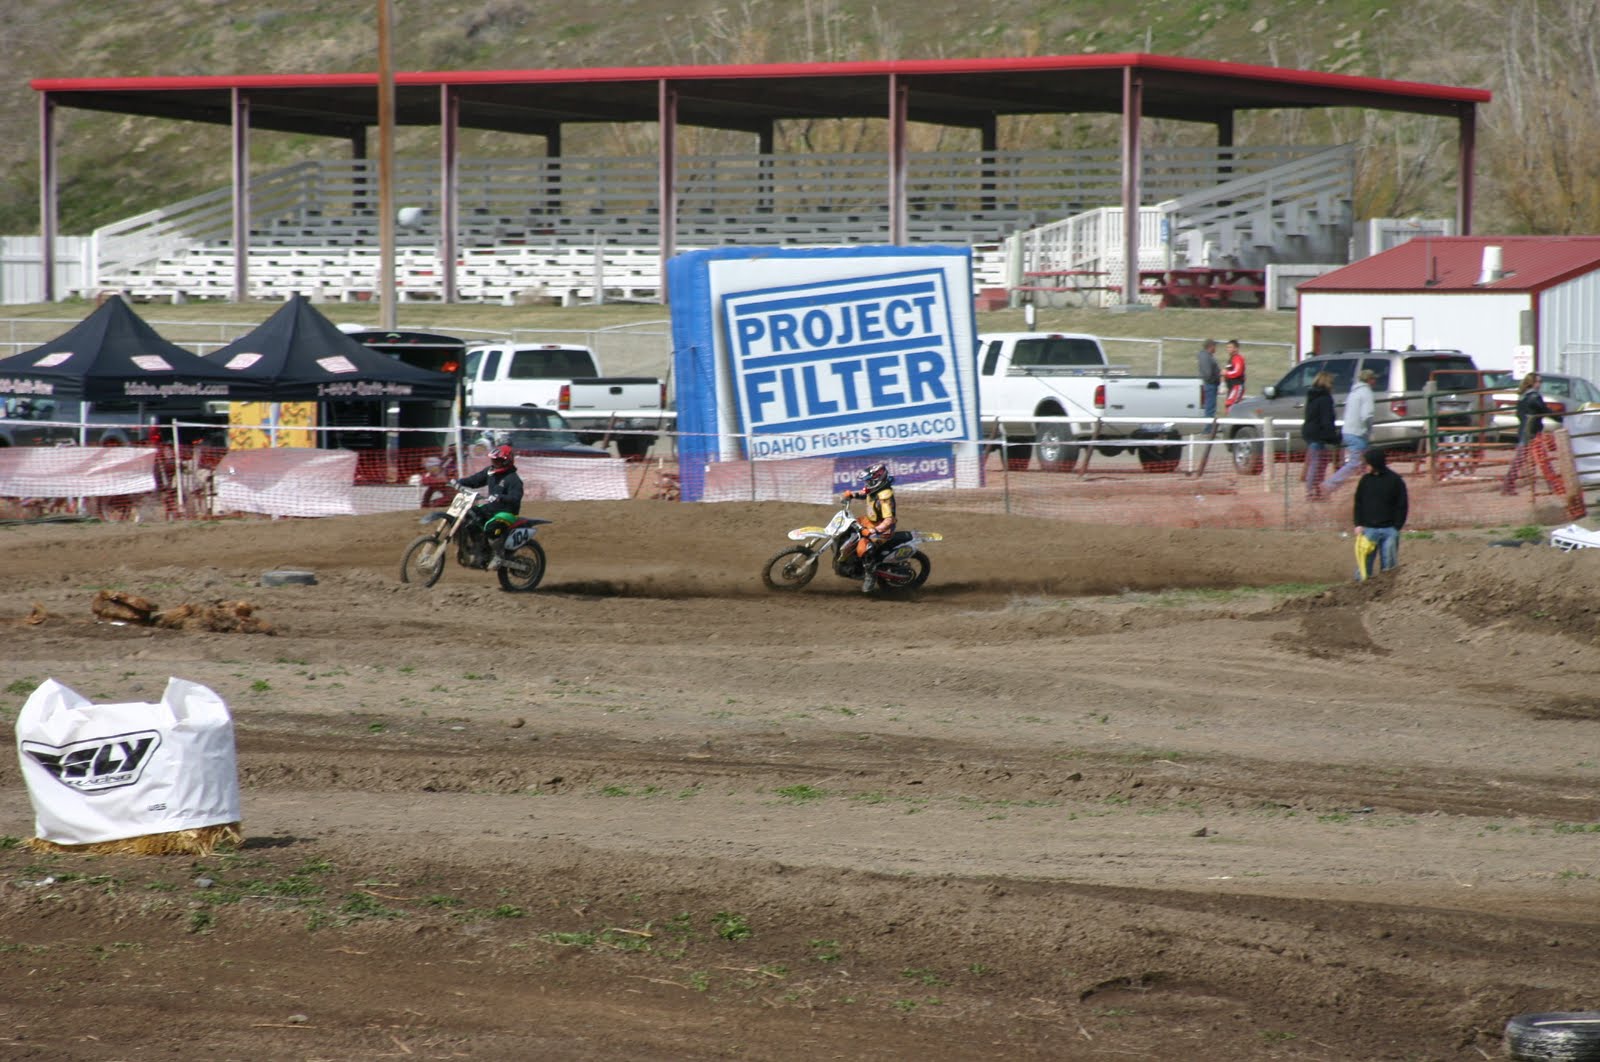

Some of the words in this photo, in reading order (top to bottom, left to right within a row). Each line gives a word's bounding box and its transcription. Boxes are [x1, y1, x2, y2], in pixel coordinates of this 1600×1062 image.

[736, 296, 936, 357] PROJECT
[743, 350, 950, 424] FILTER
[752, 436, 807, 459] IDAHO
[812, 427, 872, 450] FIGHTS
[875, 417, 956, 439] TOBACCO
